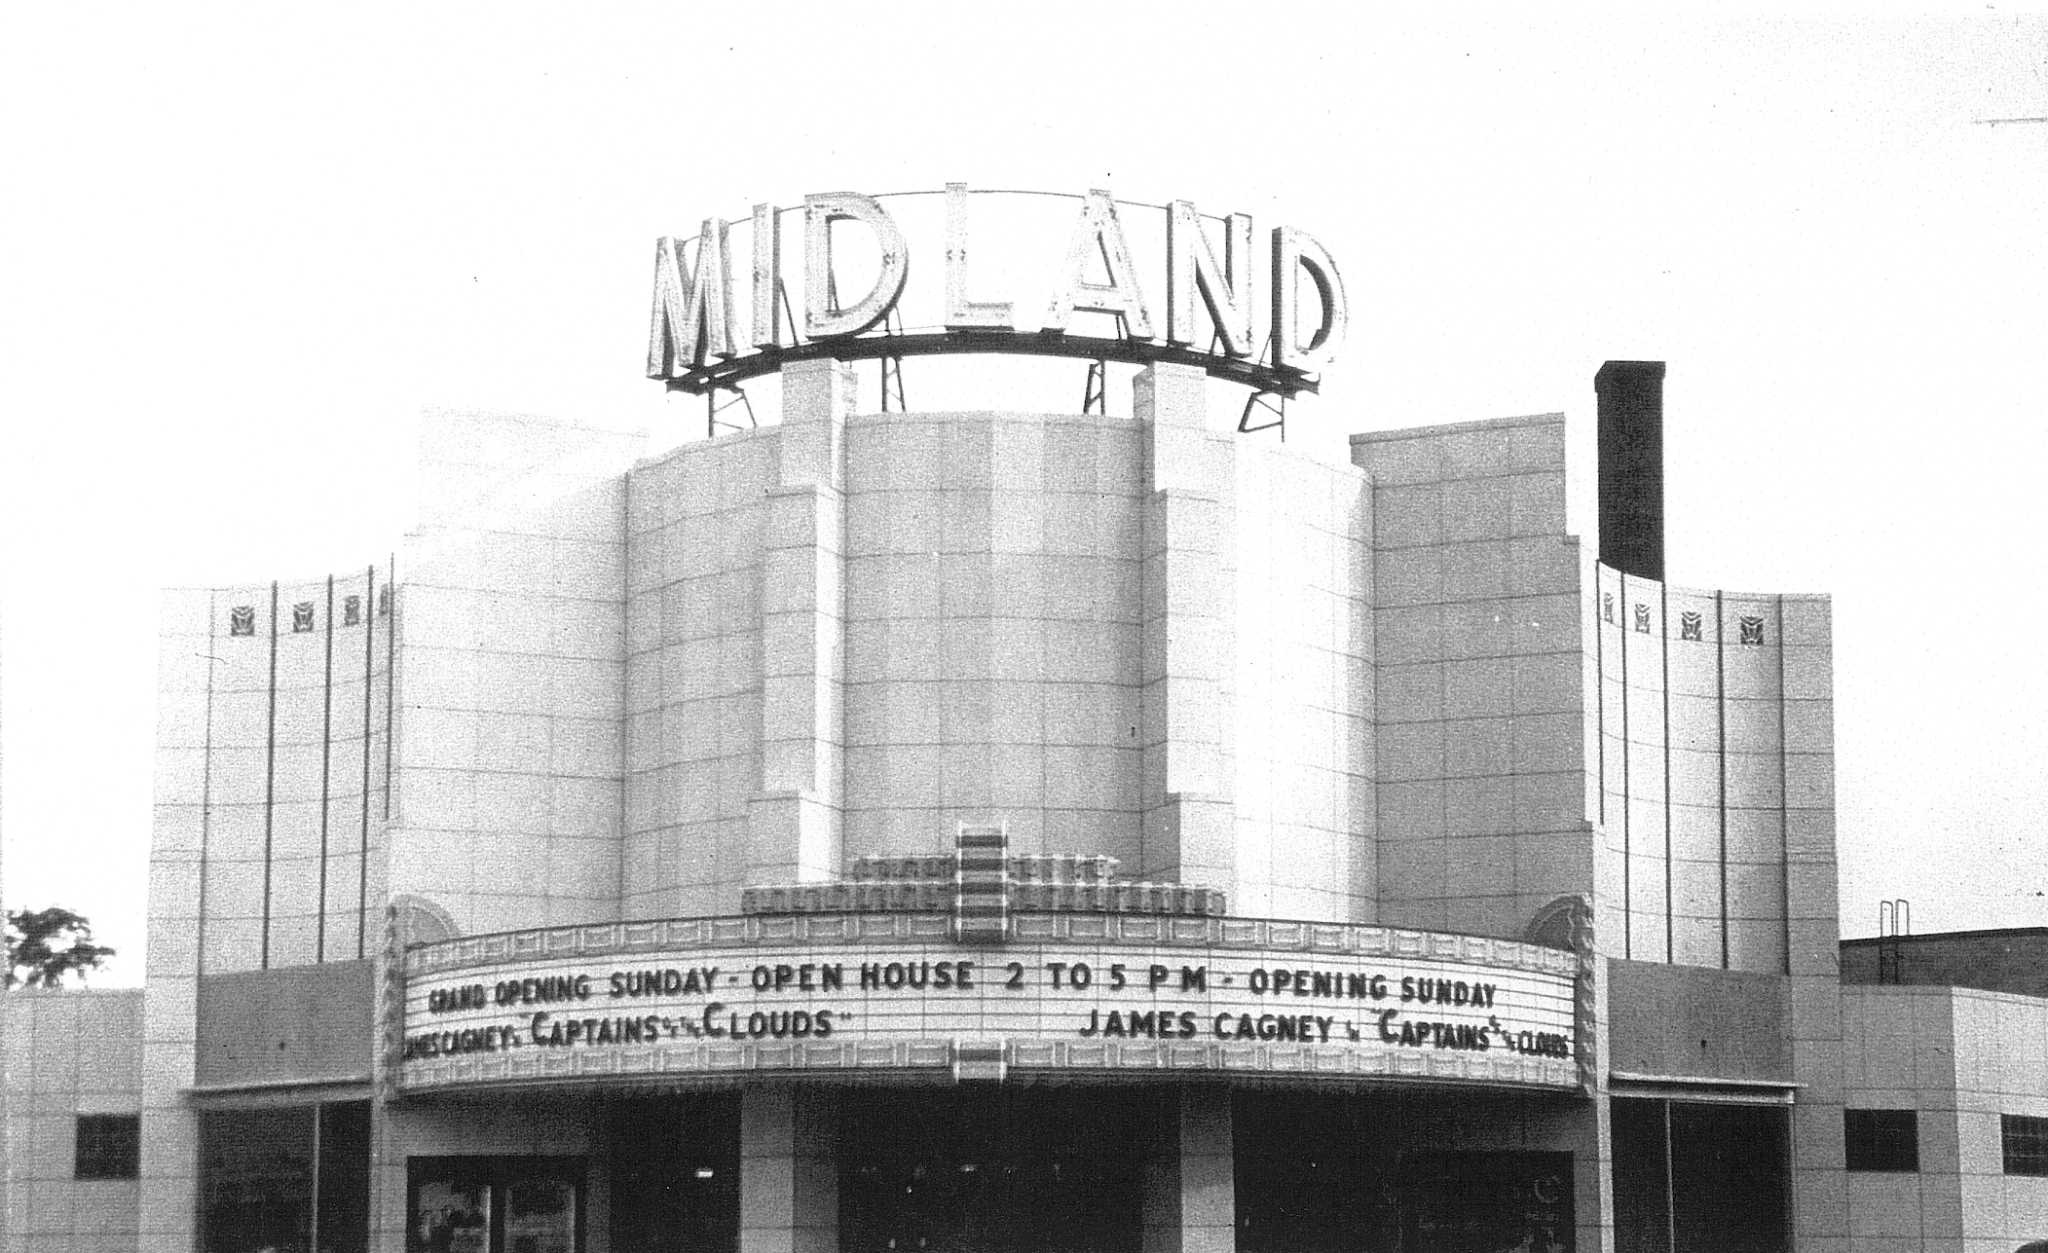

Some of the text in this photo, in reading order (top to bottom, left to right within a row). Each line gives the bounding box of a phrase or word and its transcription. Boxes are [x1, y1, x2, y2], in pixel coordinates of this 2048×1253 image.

[646, 181, 1348, 381] MIDLAND
[495, 974, 592, 1007] OPENING
[609, 966, 719, 998] SUNDAY
[752, 963, 843, 992] OPEN
[860, 961, 975, 991] HOUSE
[1005, 961, 1025, 991] 2
[1047, 961, 1093, 991] TO
[1109, 963, 1127, 991] 5
[1149, 963, 1169, 994] P
[1181, 964, 1207, 994] M
[1250, 968, 1388, 1000] OPENING
[1401, 975, 1497, 1009] SUNDAY
[1079, 1008, 1198, 1039] JAMES
[1213, 1011, 1334, 1043] CAGNEY
